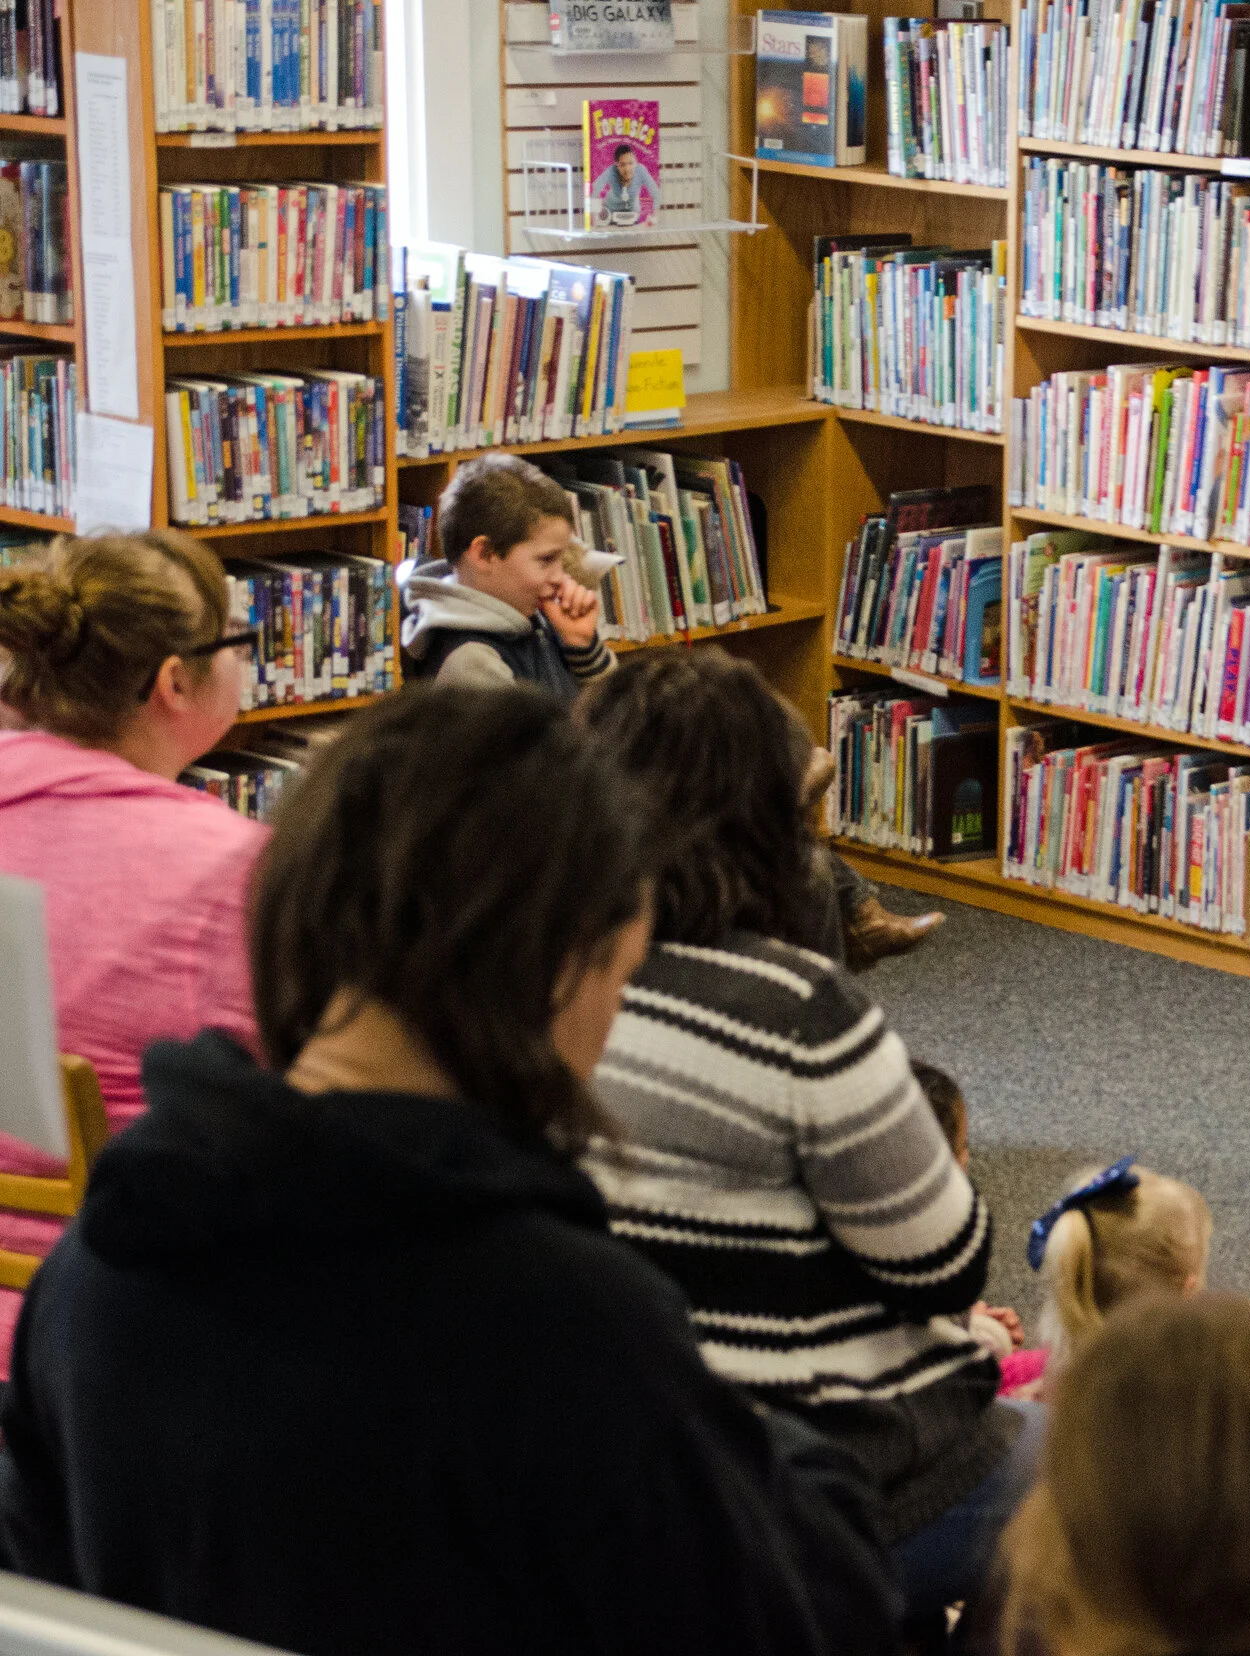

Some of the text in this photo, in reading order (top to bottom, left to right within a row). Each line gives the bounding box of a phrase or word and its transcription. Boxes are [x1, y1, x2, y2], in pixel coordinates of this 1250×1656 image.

[573, 5, 666, 22] BIG GALAXY
[762, 33, 804, 56] Stars
[594, 108, 656, 146] Forensics
[395, 312, 405, 414] Primary Dictionary
[449, 347, 461, 394] ATLAS
